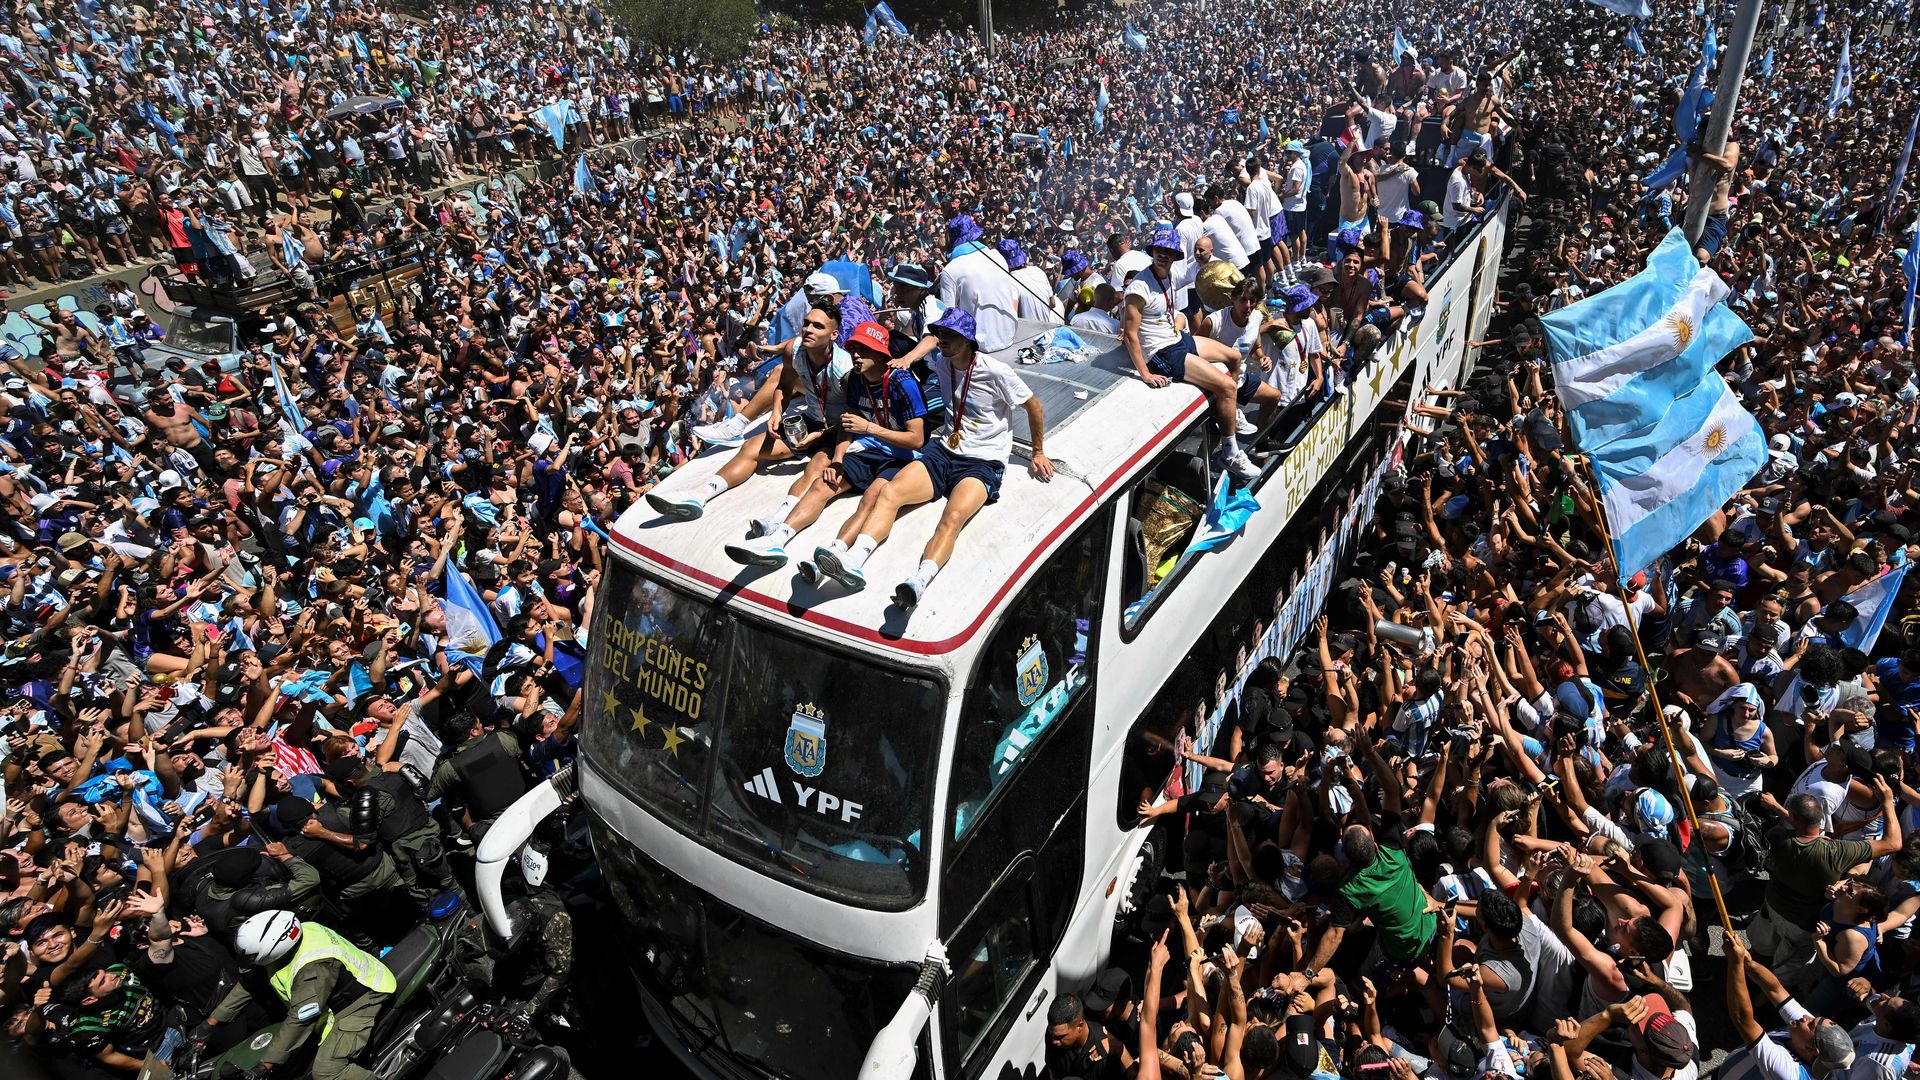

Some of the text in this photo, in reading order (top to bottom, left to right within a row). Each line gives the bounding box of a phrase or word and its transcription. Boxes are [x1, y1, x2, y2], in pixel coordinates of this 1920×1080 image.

[866, 326, 884, 342] RIVER
[1436, 329, 1455, 367] YPF
[1286, 470, 1309, 519] DEL
[605, 614, 707, 690] CAMPEONES
[603, 643, 701, 719] DEL MUNDO
[793, 781, 863, 823] YPF
